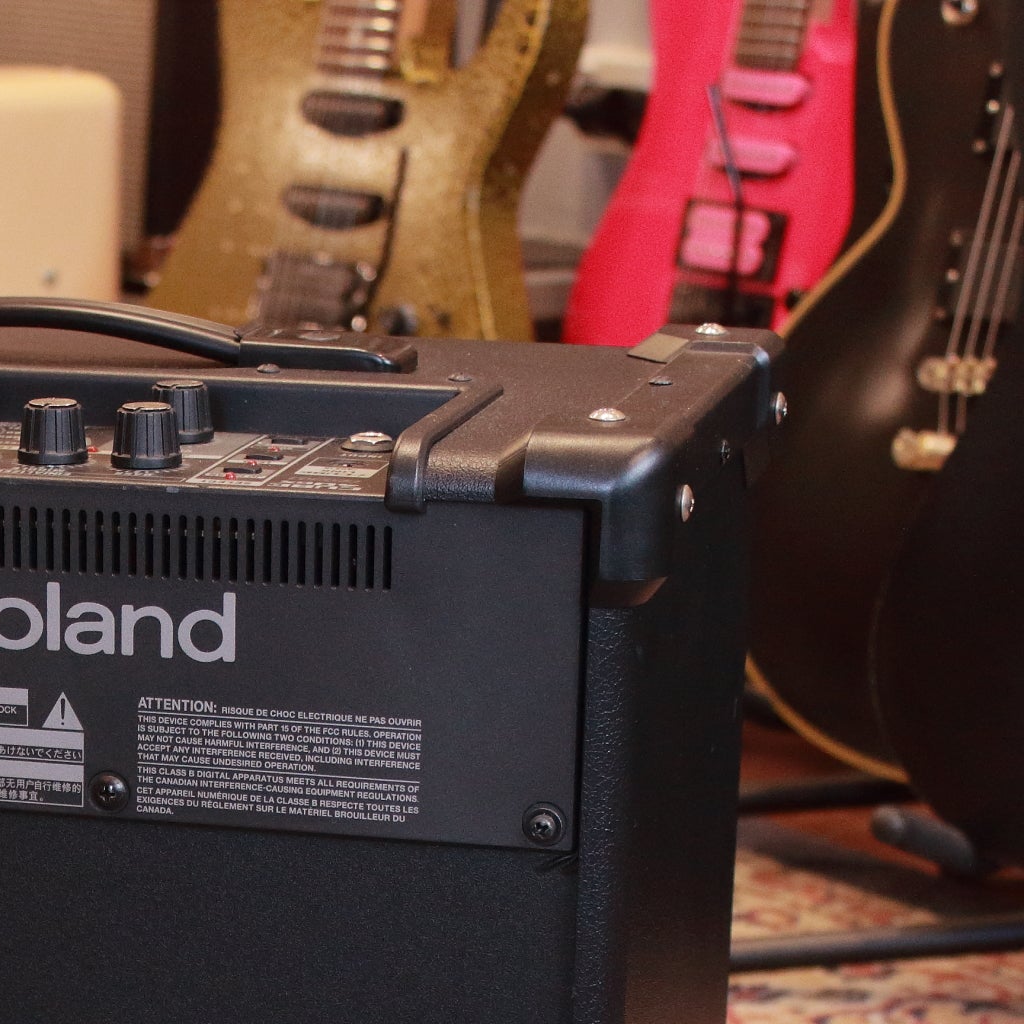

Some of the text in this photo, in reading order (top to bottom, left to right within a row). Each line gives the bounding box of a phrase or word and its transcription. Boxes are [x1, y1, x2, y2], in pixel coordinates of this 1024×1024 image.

[138, 697, 422, 727] ATTENTION: RISQUE DE CHOC ELECTRIQUE NE PAS OUVRIR
[138, 715, 157, 724] THIS
[158, 716, 188, 726] DEVICE
[190, 718, 232, 729] COMPLIES
[233, 721, 255, 730] WITH
[257, 723, 278, 732] PART
[281, 724, 289, 732] 15
[291, 725, 302, 733] OF
[304, 726, 321, 735] THE
[322, 727, 340, 736] FCC
[373, 730, 422, 741] OPERATION
[138, 724, 145, 732] IS
[147, 725, 186, 735] SUBJECT
[189, 728, 200, 736] TO
[202, 729, 219, 737] THE
[221, 730, 272, 741] FOLLOWING
[275, 733, 295, 742] TWO
[297, 735, 353, 746] CONDITIONS:
[367, 740, 387, 748] THIS
[389, 741, 421, 751] DEVICE
[137, 734, 154, 743] MAY
[156, 735, 173, 744] NOT
[175, 737, 203, 746] CAUSE
[204, 739, 244, 749] HARMFUL
[313, 746, 330, 754] AND
[343, 748, 363, 756] THIS
[364, 749, 395, 759] DEVICE
[397, 751, 421, 760] MUST
[137, 743, 171, 753] ACCEPT
[173, 746, 190, 754] ANY
[192, 747, 256, 759] INTERFERENCE
[305, 755, 352, 765] INCLUDING
[354, 758, 420, 770] INTERFERENCE
[137, 753, 316, 772] THAT MAY CAUSE UNDESIRED OPERATION.
[137, 766, 420, 793] THIS CLASS B DIGITAL APPARATUS MEETS ALL REQUIREMENTS OF
[137, 775, 153, 784] THE
[155, 777, 198, 787] CANADIAN
[200, 780, 304, 795] INTERFERENCE-CAUSING
[305, 787, 355, 798] EQUIPMENT
[136, 805, 174, 815] CANADA.
